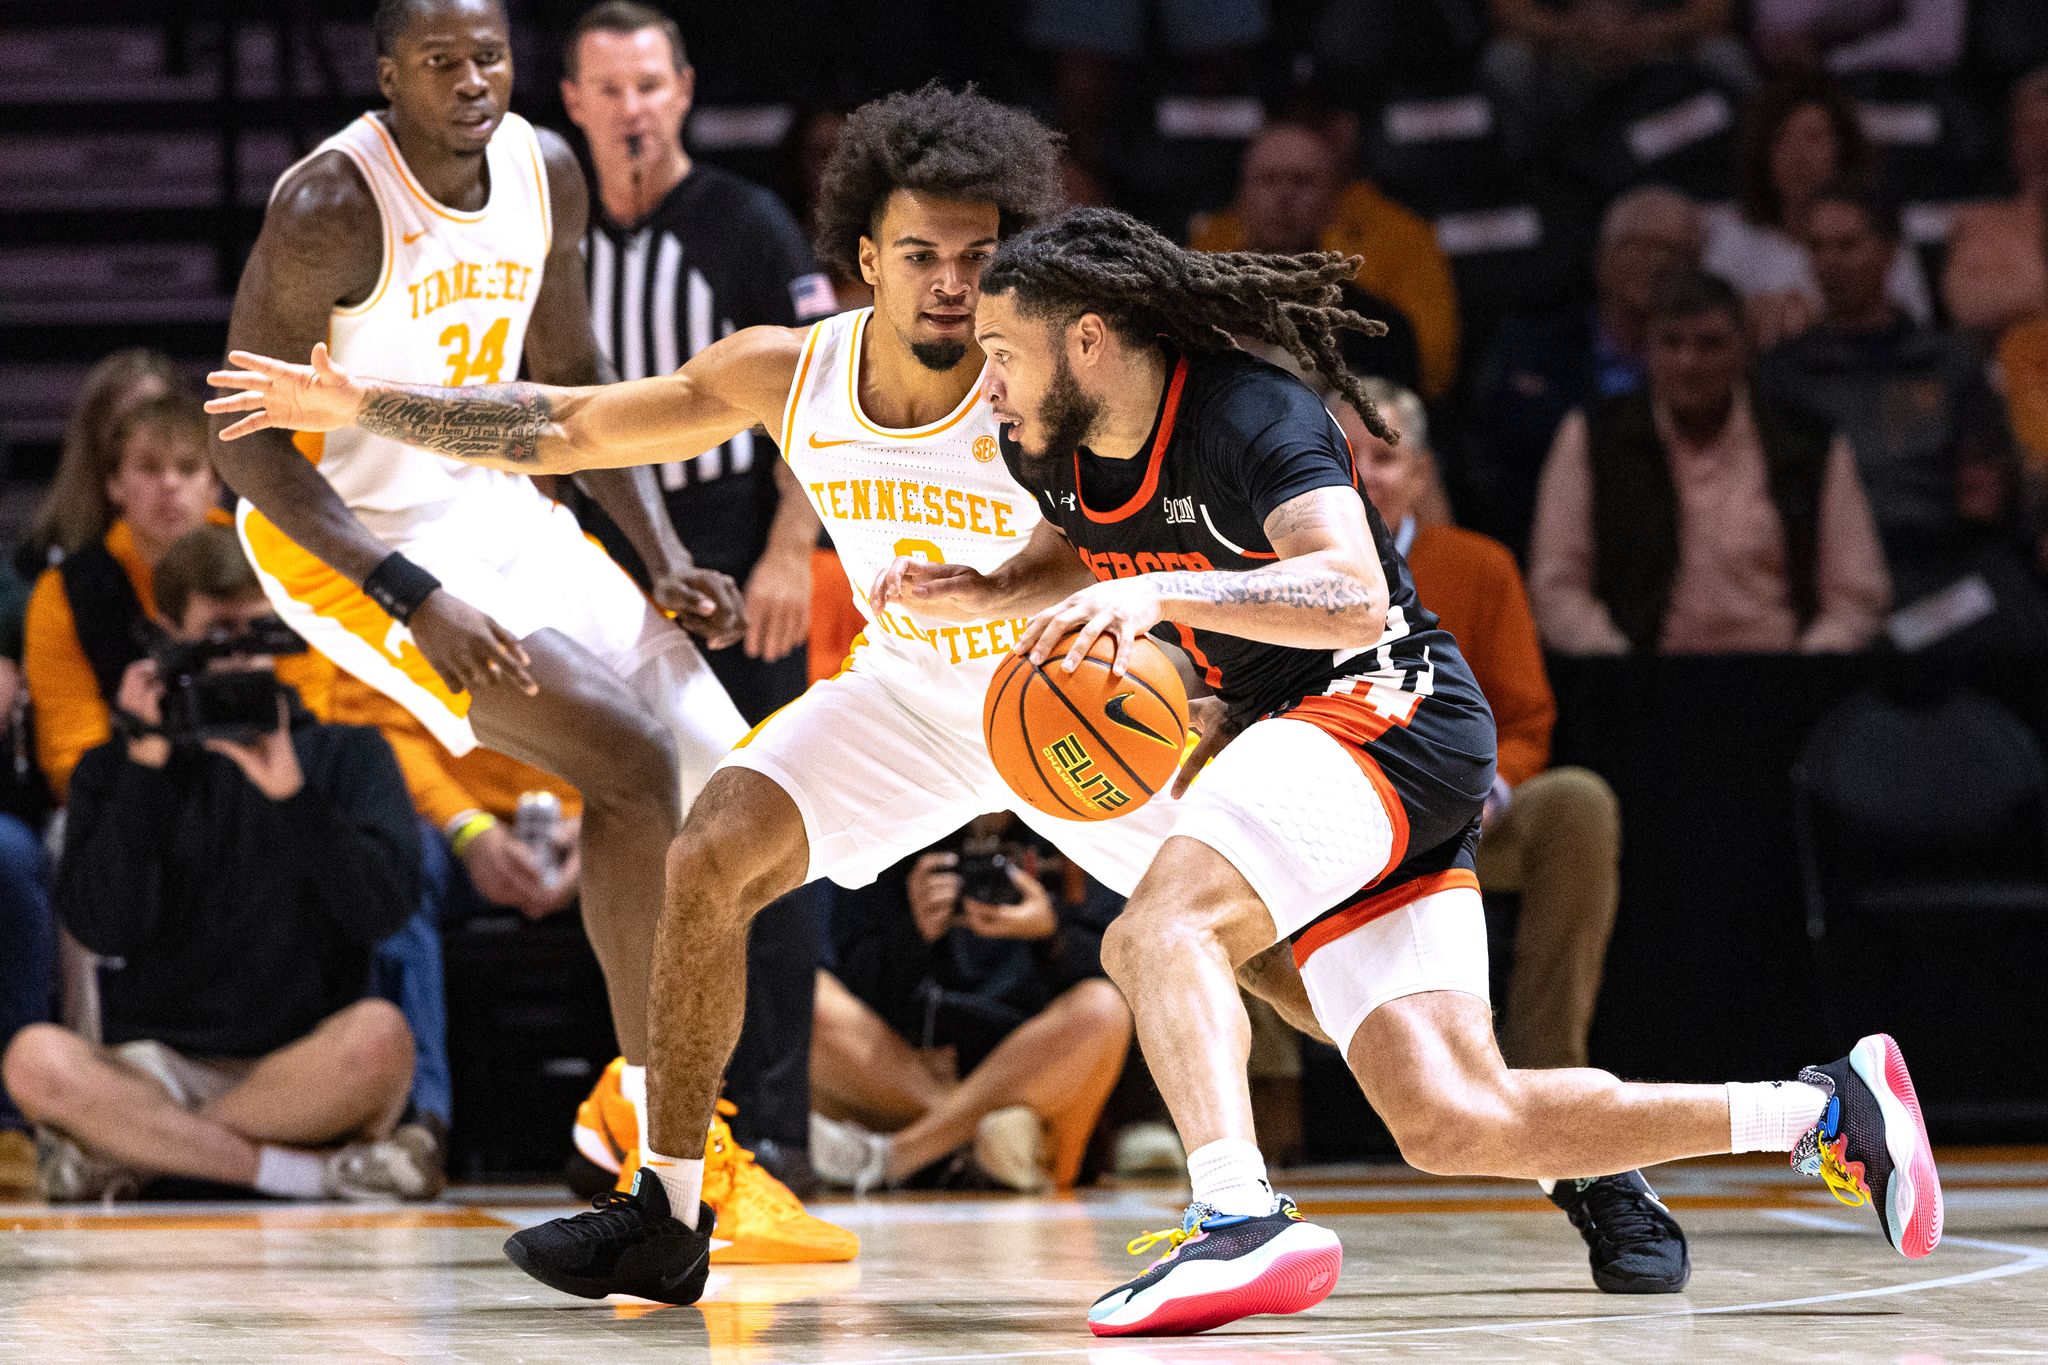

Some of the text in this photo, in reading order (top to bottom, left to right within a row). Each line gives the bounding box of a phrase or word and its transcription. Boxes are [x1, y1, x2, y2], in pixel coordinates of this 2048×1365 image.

[438, 317, 510, 387] 34
[439, 426, 464, 436] them
[442, 400, 526, 430] Family
[974, 438, 995, 460] SEC
[810, 479, 1016, 537] TENNESSEE
[1049, 731, 1133, 812] ELITE
